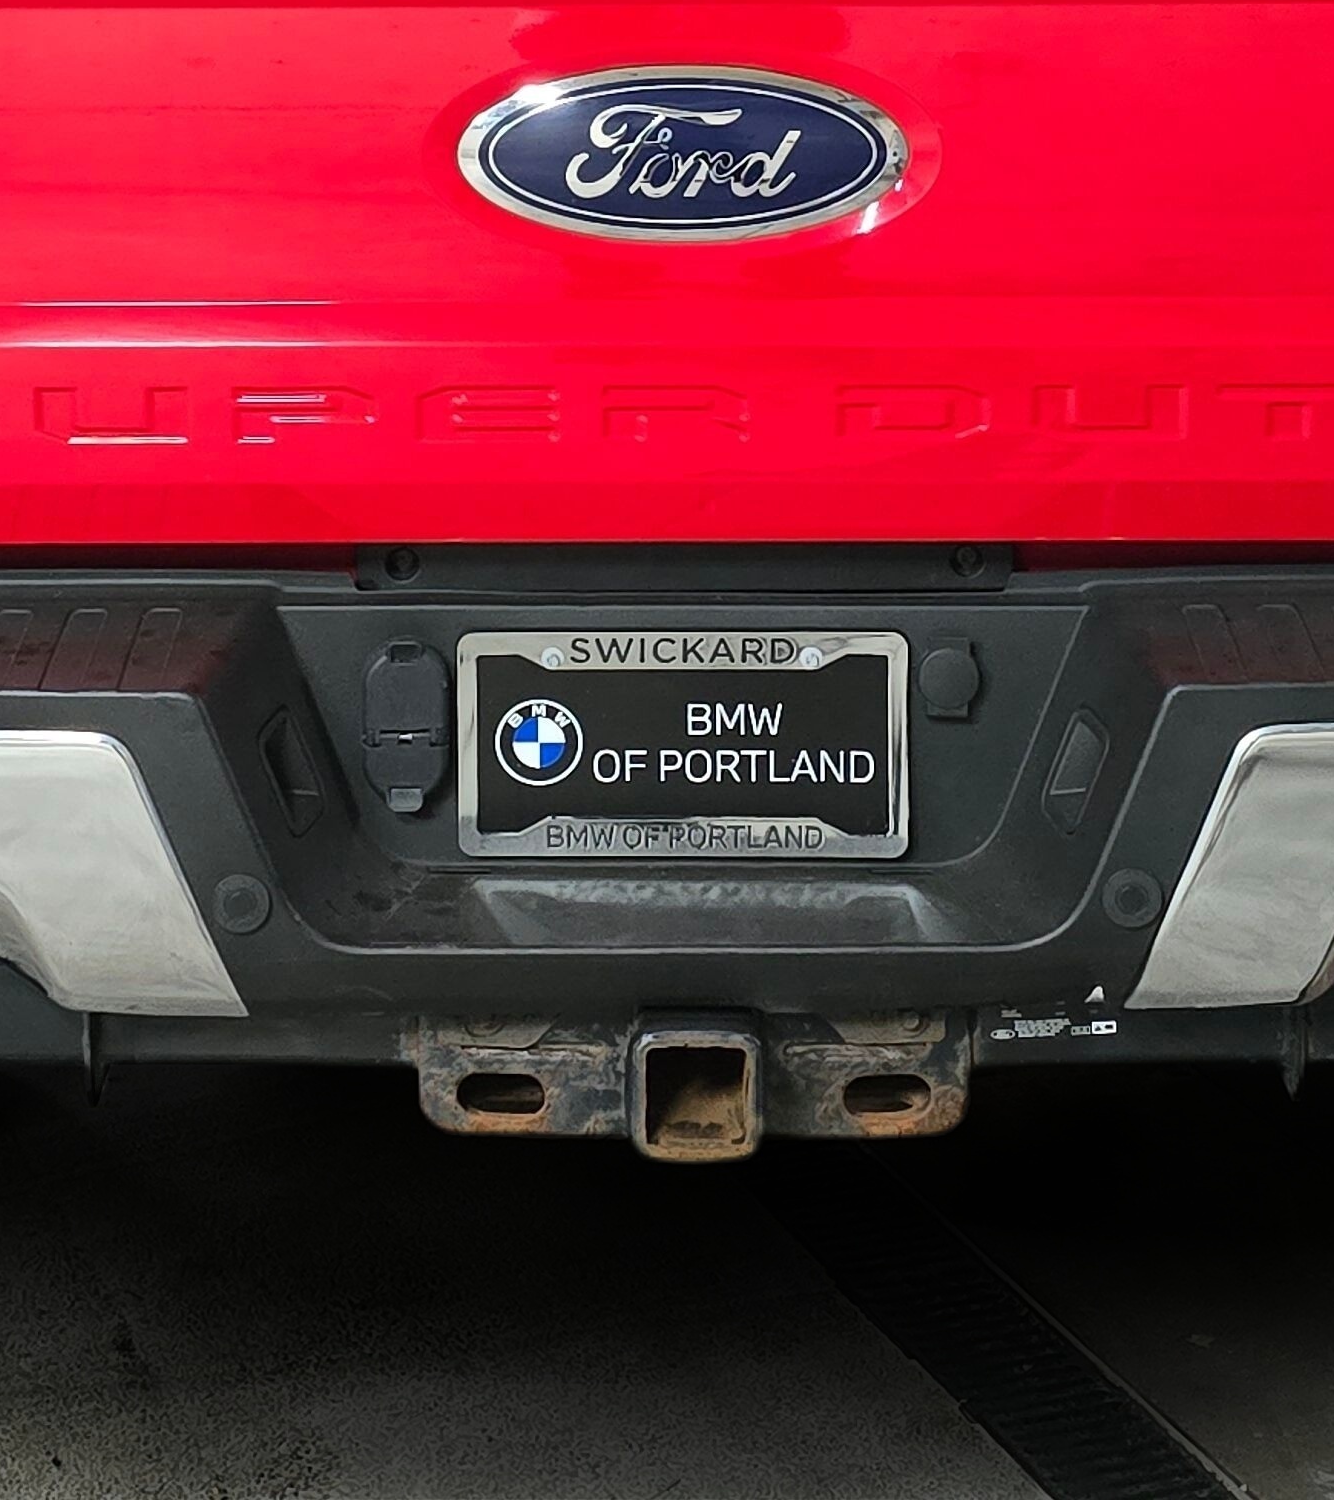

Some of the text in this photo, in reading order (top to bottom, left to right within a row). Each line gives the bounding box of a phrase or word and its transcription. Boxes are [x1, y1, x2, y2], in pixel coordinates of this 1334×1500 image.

[566, 104, 801, 199] Ford
[569, 637, 796, 666] SWICKARD
[508, 704, 571, 729] BMW
[686, 702, 783, 736] BMW
[592, 749, 875, 784] OF PORTLAND
[546, 825, 824, 850] BMW OF PORTLAND
